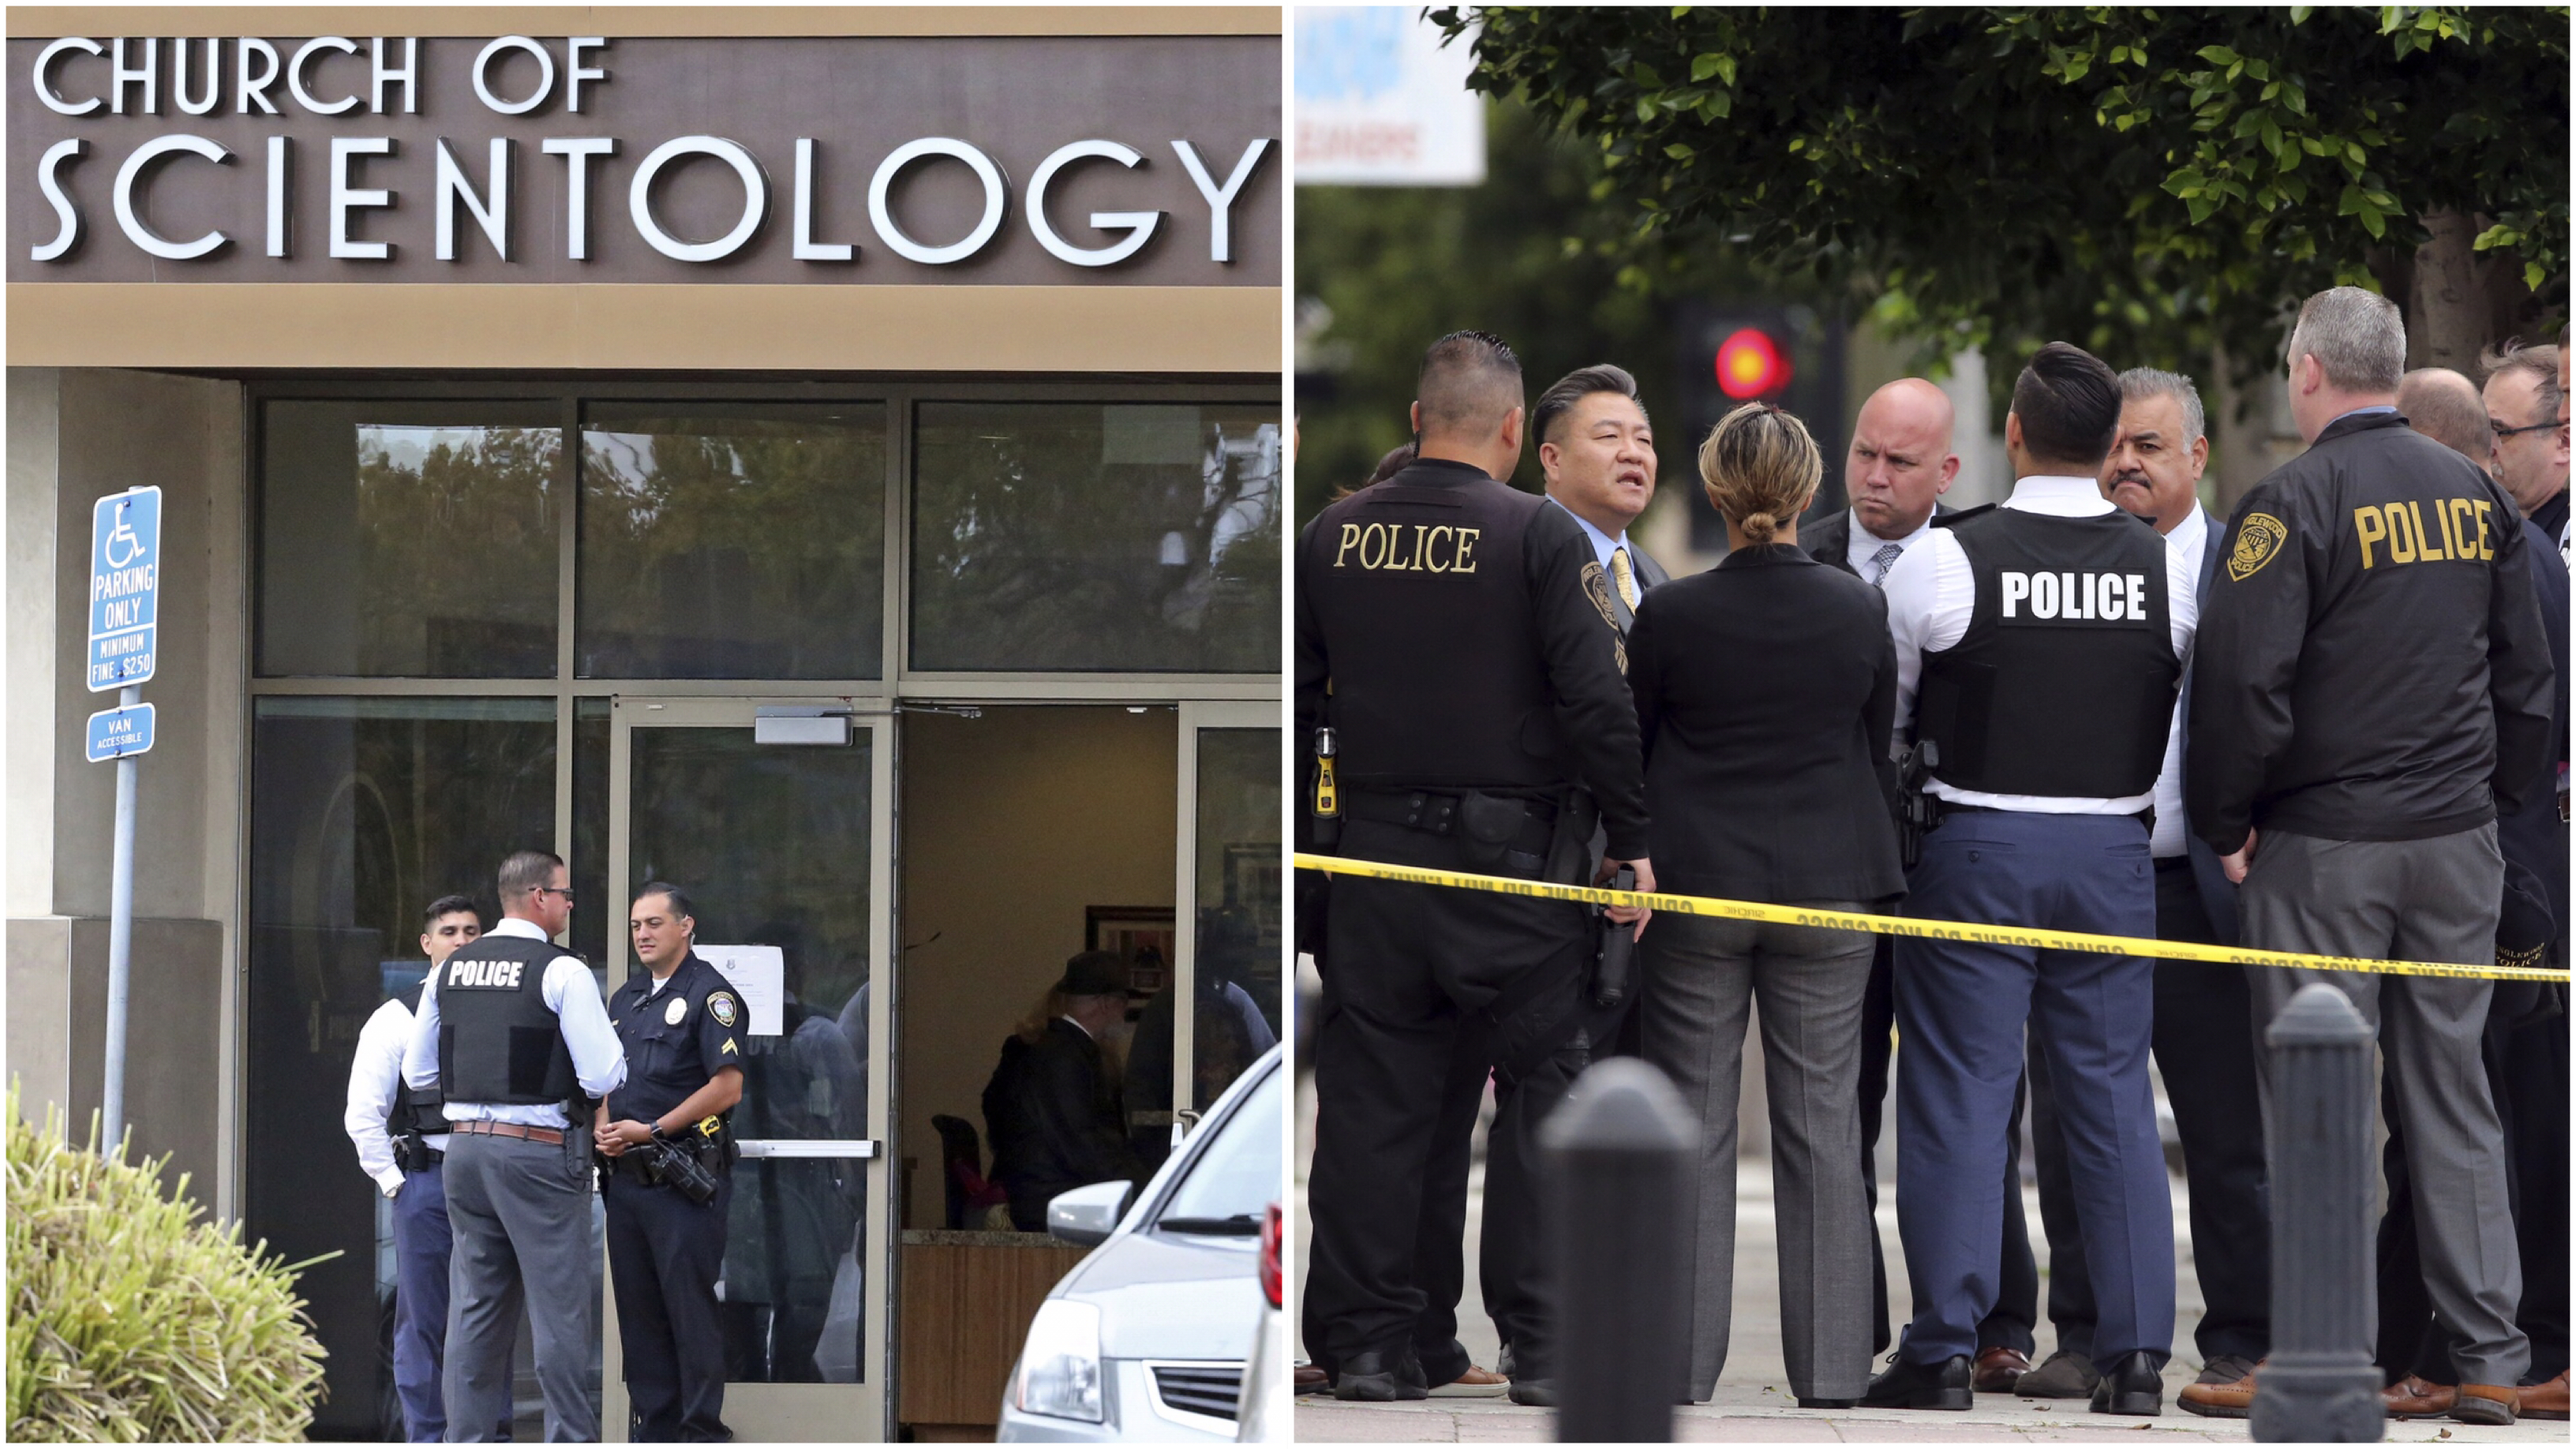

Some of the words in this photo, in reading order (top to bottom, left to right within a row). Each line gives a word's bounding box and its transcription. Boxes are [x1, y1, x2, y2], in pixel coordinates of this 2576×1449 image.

[33, 36, 417, 116] CHURCH
[473, 35, 610, 114] OF
[31, 134, 1277, 267] SCIENTOLOGY
[2245, 516, 2283, 539] GLEWOOD
[2353, 498, 2494, 570] POLICE
[1334, 522, 1481, 573] POLICE
[2231, 556, 2256, 572] POLICE
[95, 563, 153, 601] PARKING
[2001, 571, 2146, 620] POLICE
[104, 597, 141, 630] ONLY
[99, 632, 144, 658] MINIMUM
[92, 661, 115, 682] FINE
[122, 653, 151, 677] $250
[96, 732, 142, 750] ACCESSIBLE
[108, 717, 132, 734] VAN
[447, 960, 523, 987] POLICE
